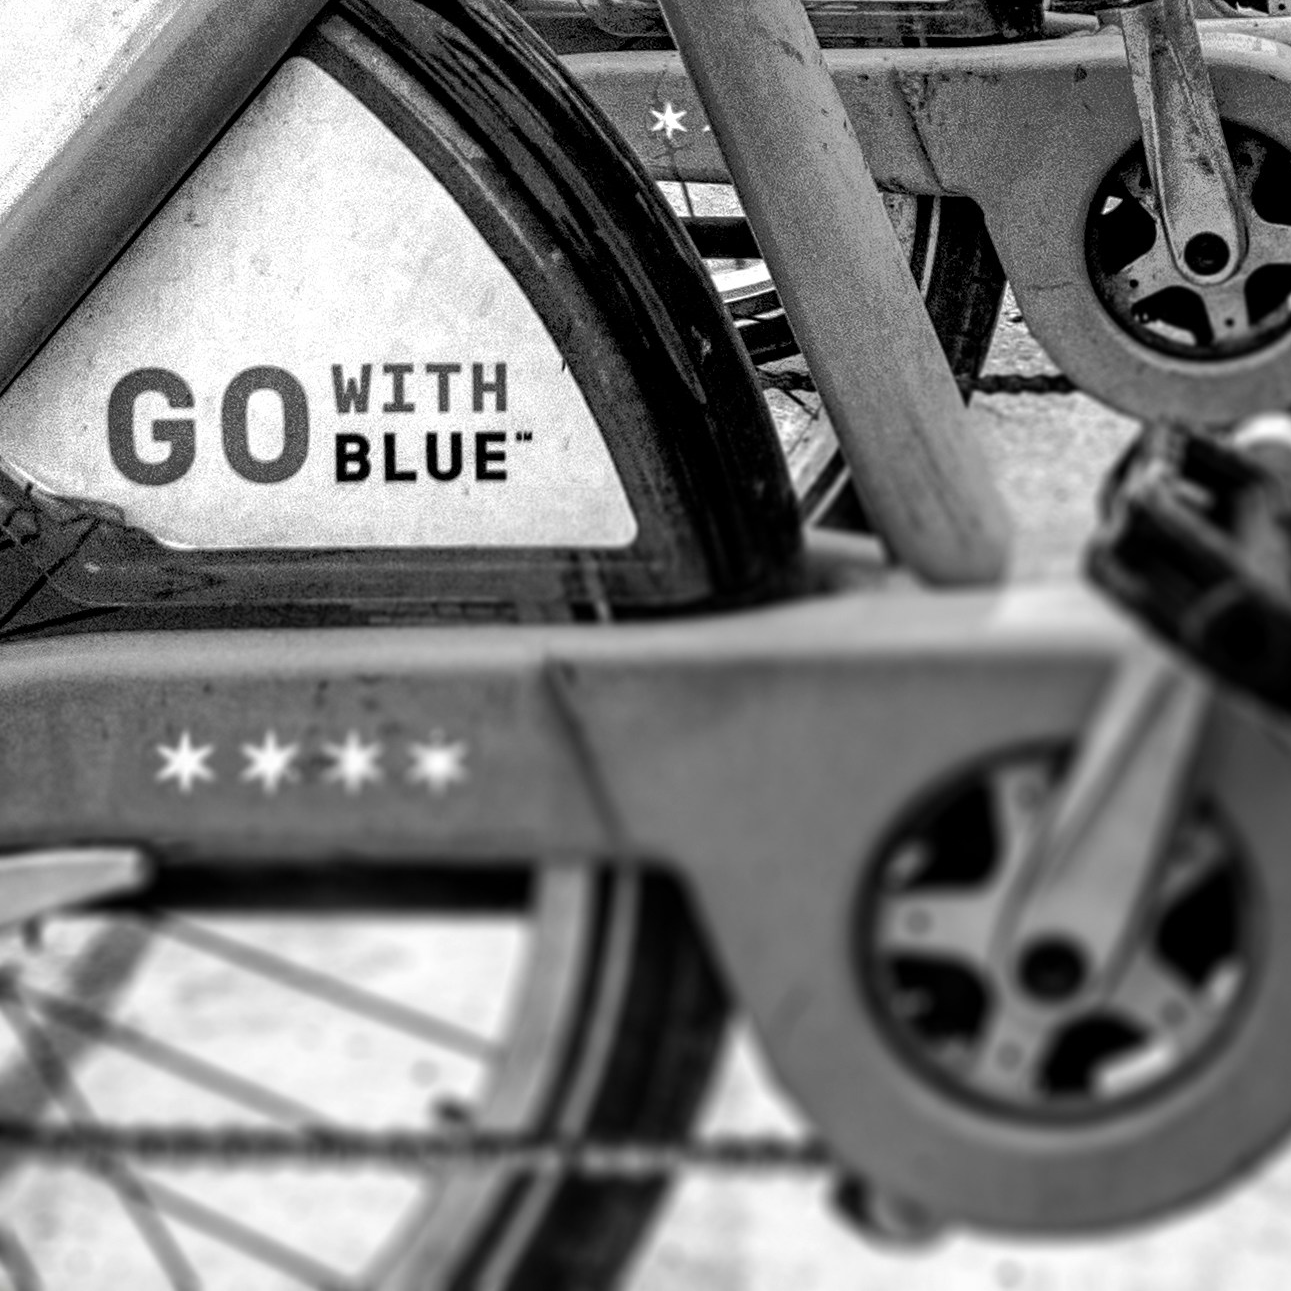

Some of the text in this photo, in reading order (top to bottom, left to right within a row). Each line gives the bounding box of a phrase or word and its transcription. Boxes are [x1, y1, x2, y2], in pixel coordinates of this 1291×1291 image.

[107, 362, 507, 485] GO WITH
[335, 431, 507, 483] BLUE
